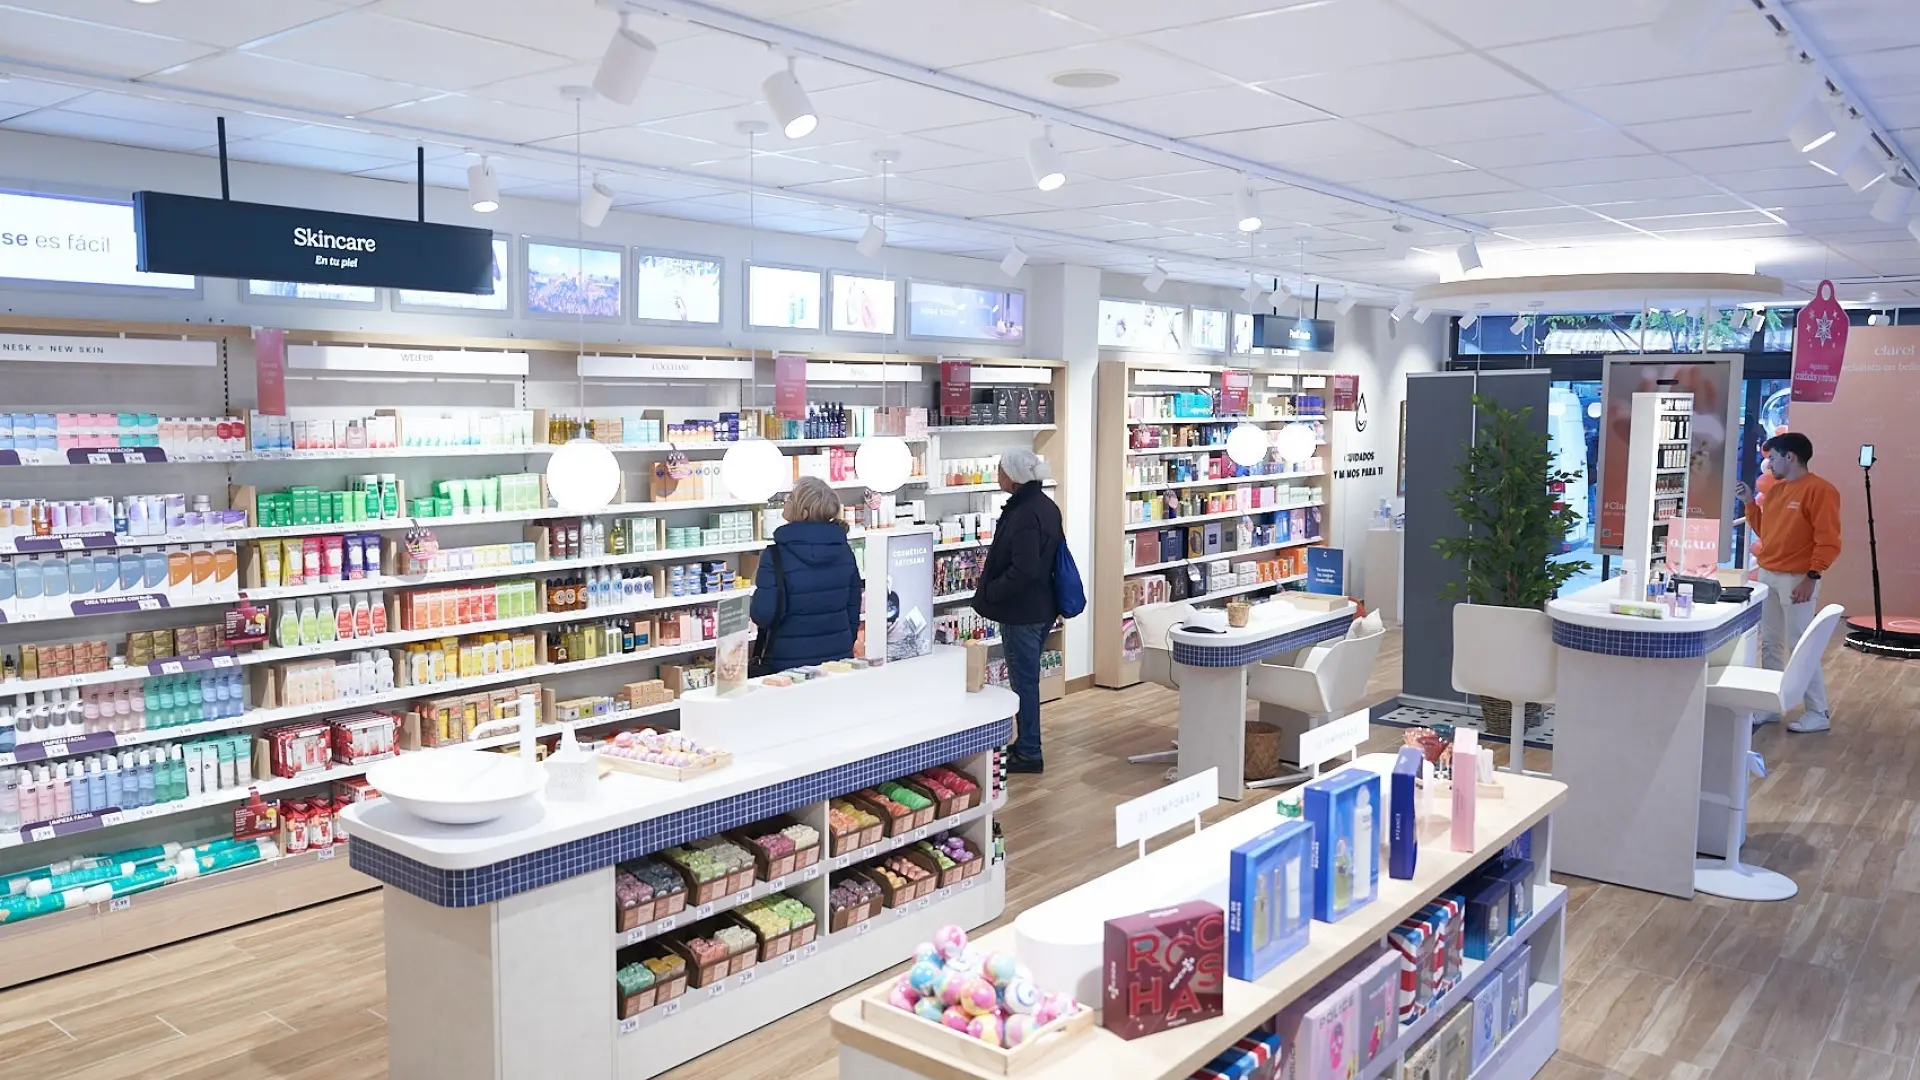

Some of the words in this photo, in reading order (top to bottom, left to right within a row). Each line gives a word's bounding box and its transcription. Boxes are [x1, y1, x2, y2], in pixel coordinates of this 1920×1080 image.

[35, 234, 61, 250] es
[67, 233, 111, 253] fácil
[293, 227, 377, 252] Skincare
[315, 255, 328, 265] En
[329, 256, 341, 267] tu
[340, 258, 359, 269] piel
[50, 345, 73, 353] NEW
[1361, 467, 1377, 477] PARA
